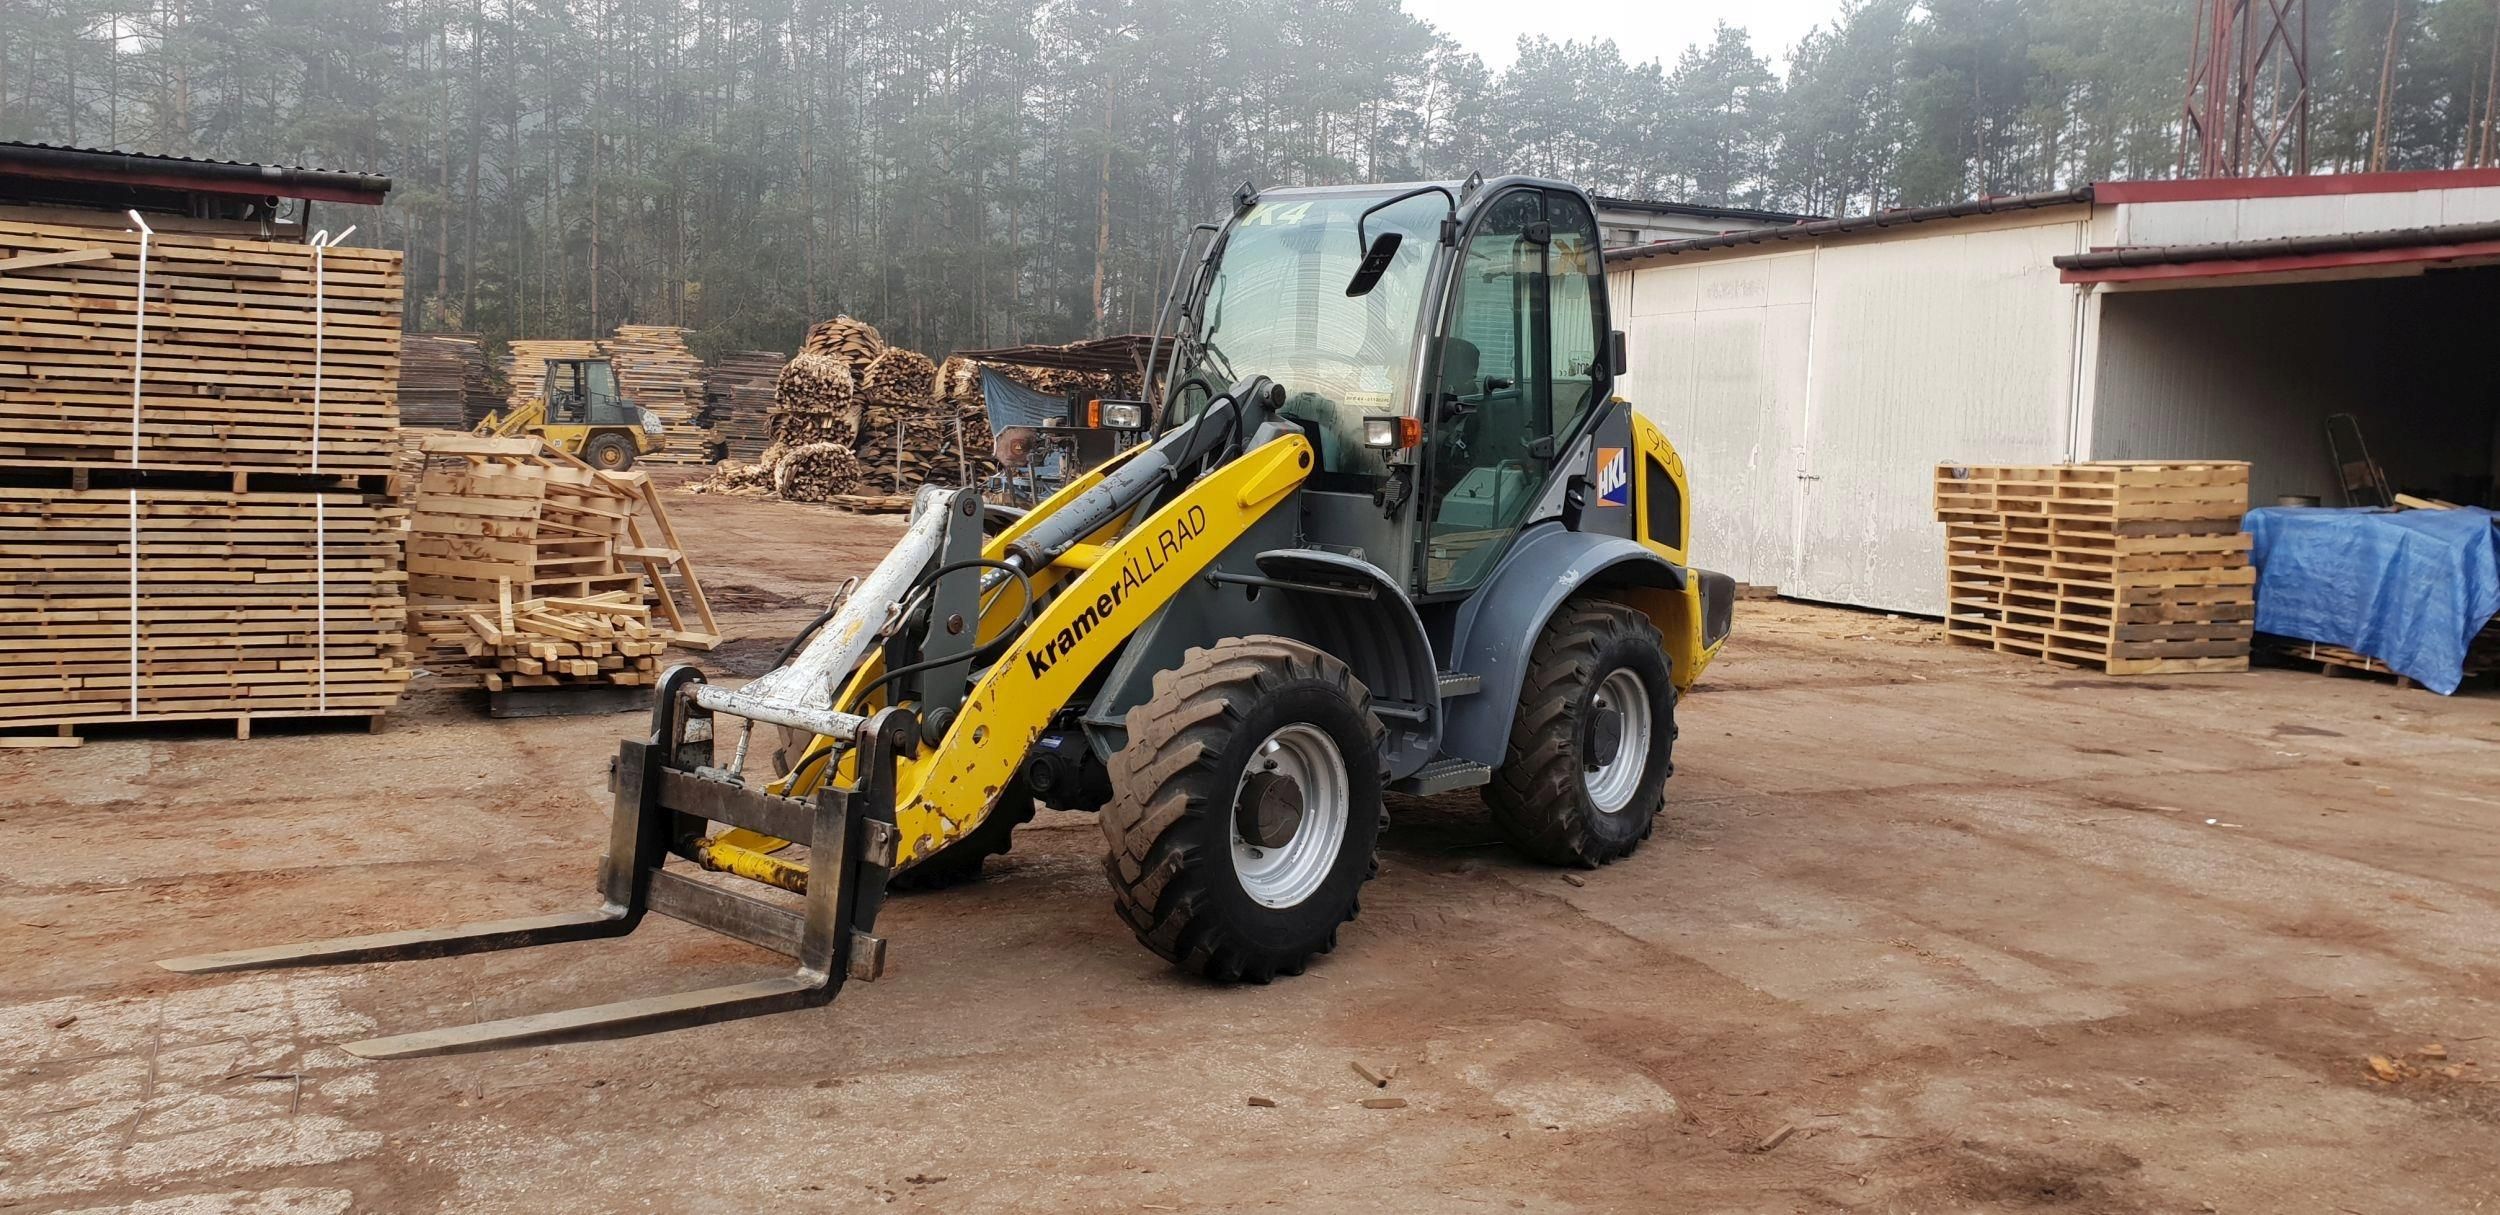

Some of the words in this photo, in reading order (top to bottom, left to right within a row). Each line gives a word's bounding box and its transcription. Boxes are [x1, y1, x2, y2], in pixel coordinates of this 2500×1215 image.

[1240, 201, 1314, 226] K4
[1599, 449, 1627, 499] HKL
[1646, 427, 1683, 477] 950
